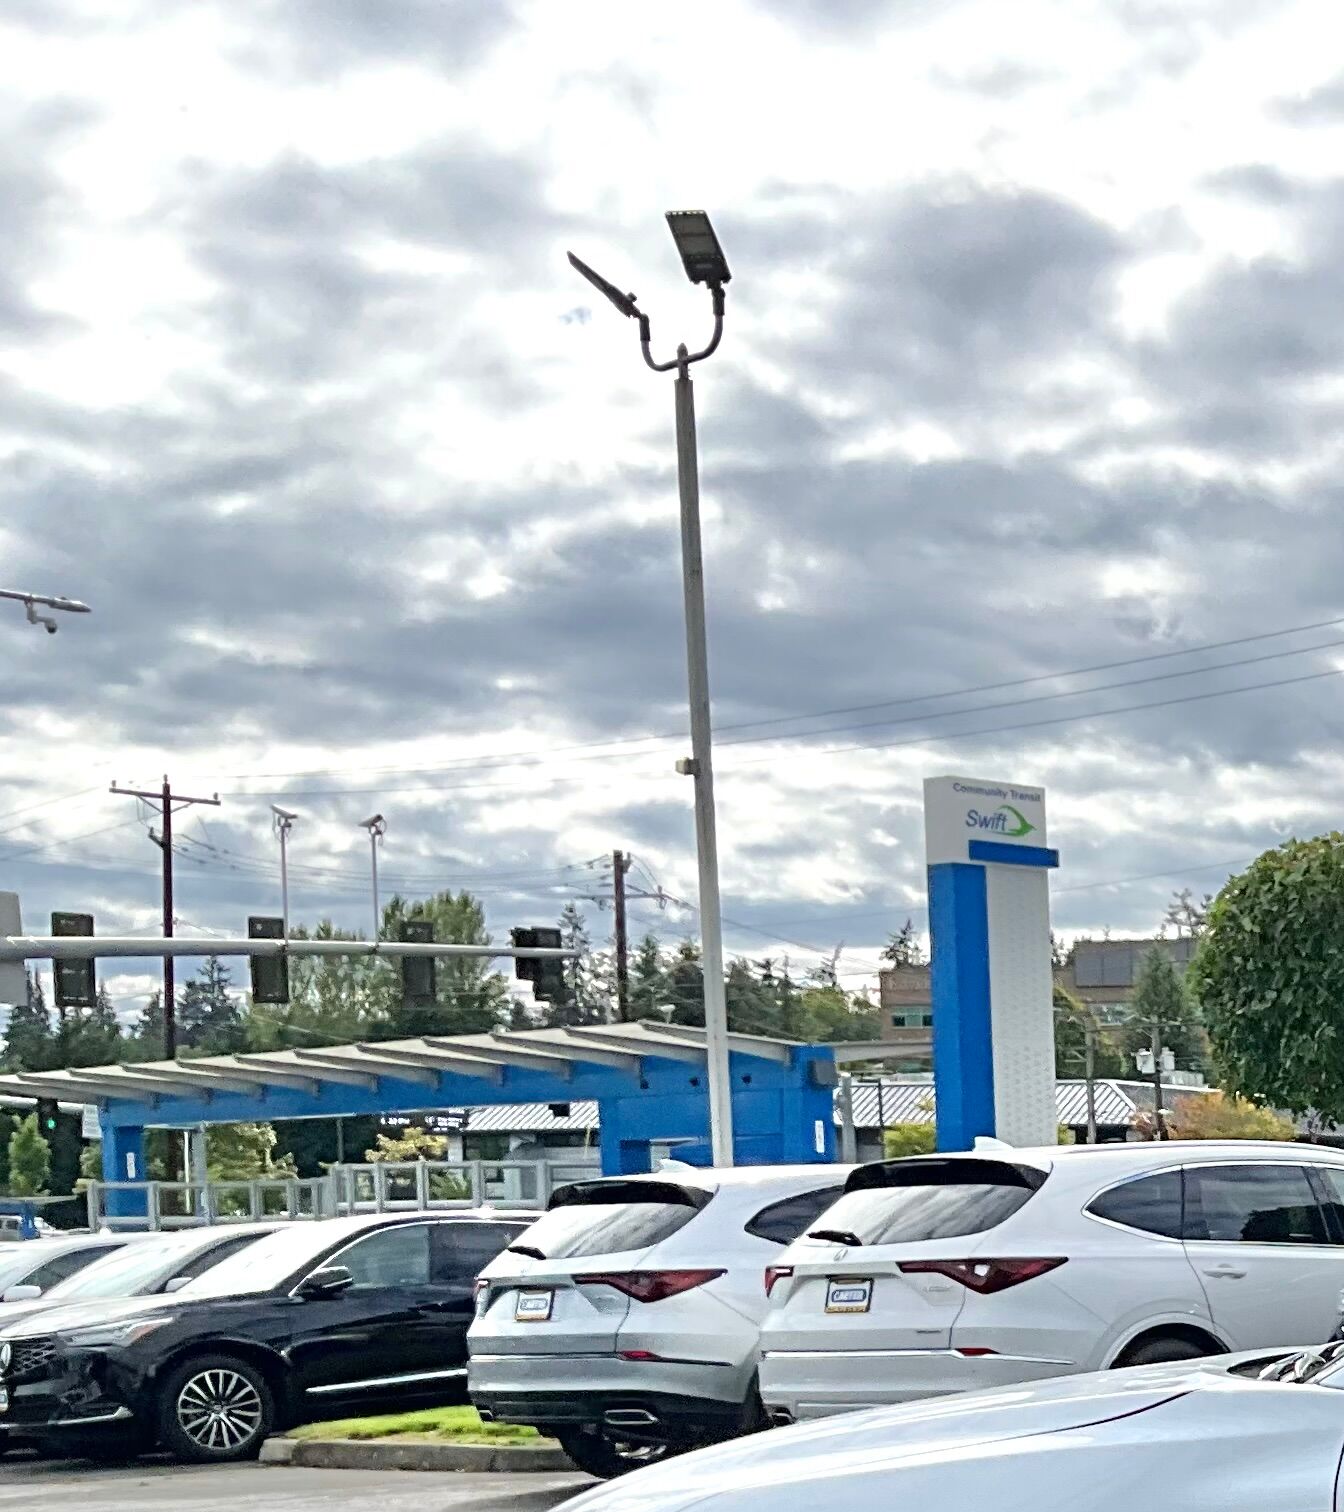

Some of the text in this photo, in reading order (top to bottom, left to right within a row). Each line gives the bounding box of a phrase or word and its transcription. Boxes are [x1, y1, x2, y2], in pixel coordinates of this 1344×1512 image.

[953, 782, 1041, 802] Community Transit
[966, 809, 1008, 831] Swift
